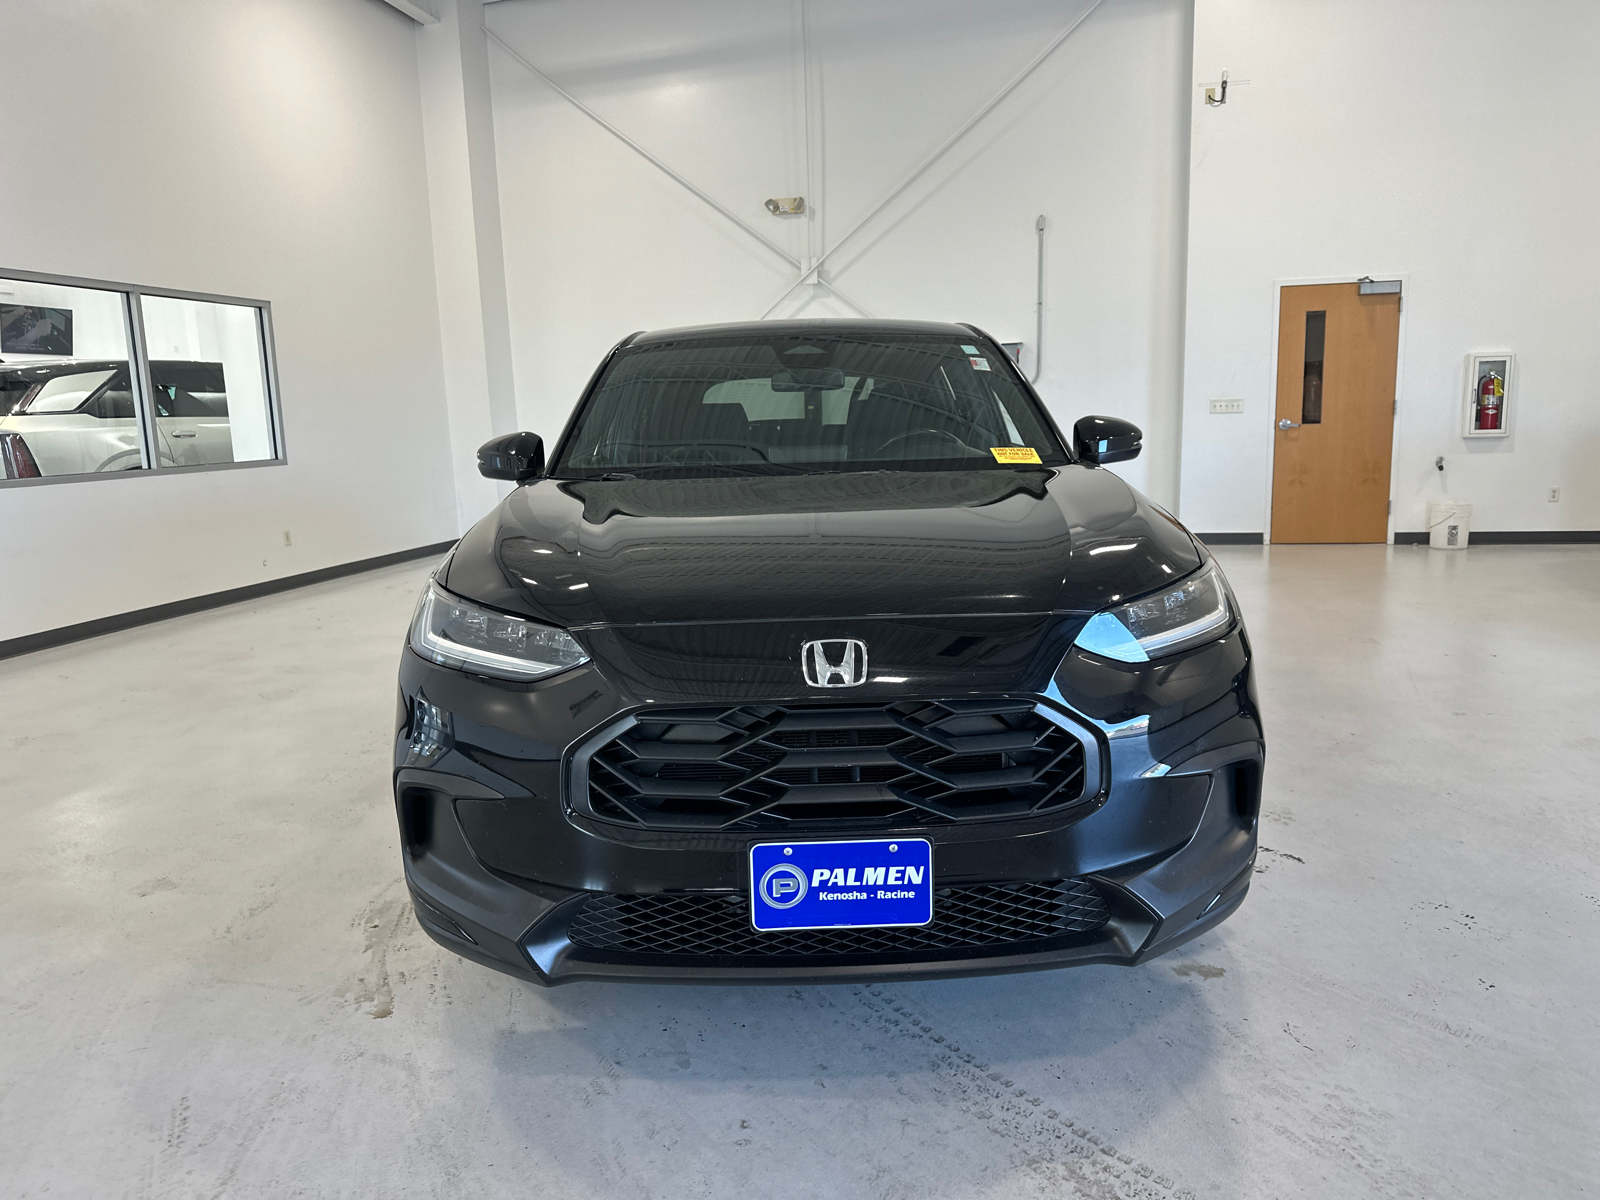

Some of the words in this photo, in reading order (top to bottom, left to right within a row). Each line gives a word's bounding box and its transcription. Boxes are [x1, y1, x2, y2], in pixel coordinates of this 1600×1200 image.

[811, 865, 925, 887] PALMEN
[772, 877, 798, 898] P
[819, 891, 867, 901] Kenosha
[877, 890, 915, 899] Racine
